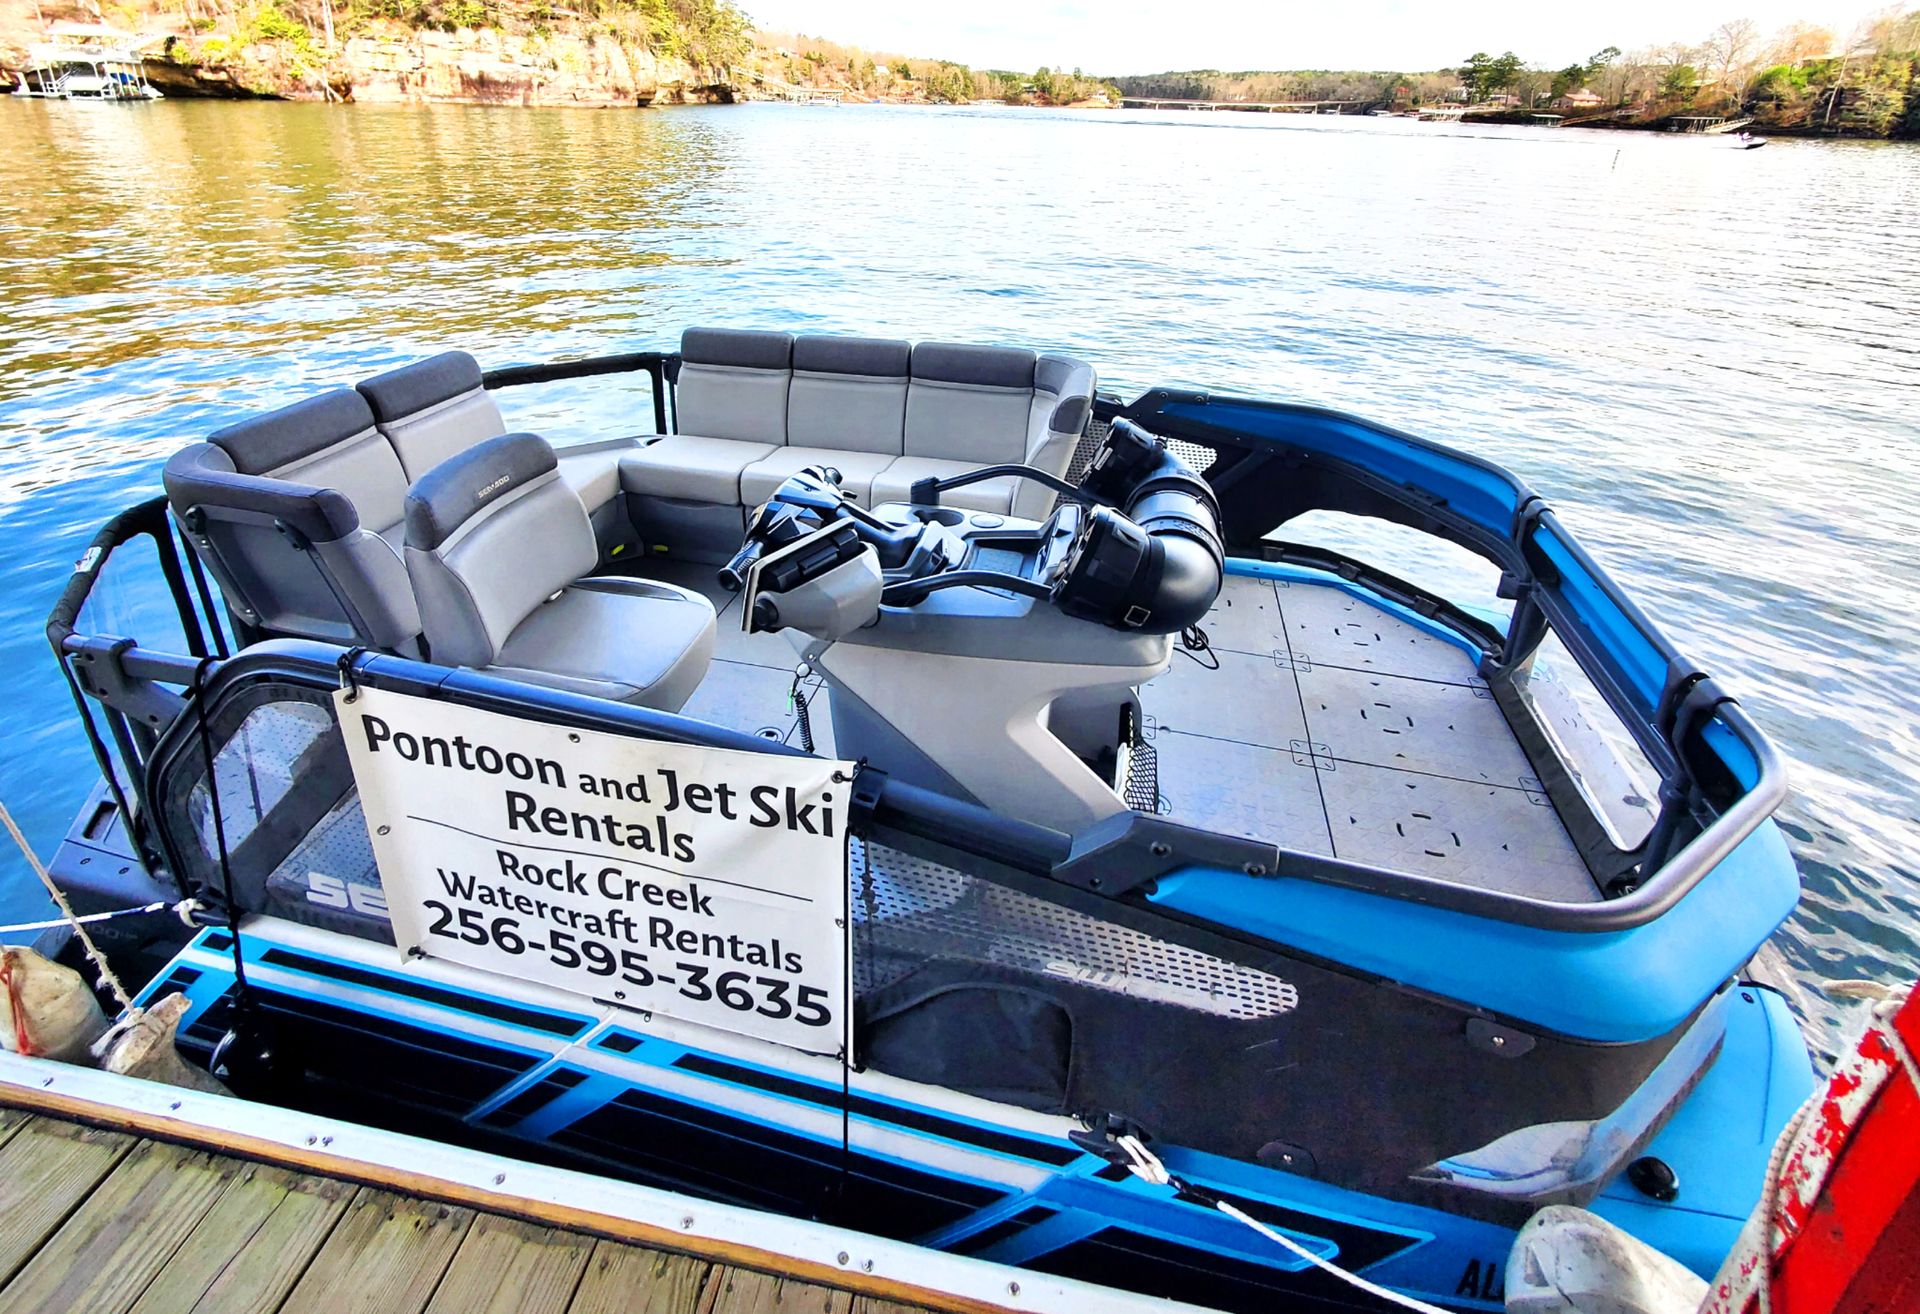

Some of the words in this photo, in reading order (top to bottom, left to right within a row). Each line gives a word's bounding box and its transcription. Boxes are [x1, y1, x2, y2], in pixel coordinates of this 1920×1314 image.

[361, 713, 567, 789] Pontoon
[578, 773, 651, 804] and
[657, 768, 737, 820] Jet
[749, 785, 834, 838] Ski
[505, 789, 696, 863] Rentals
[436, 867, 639, 944] Watercraft
[649, 916, 804, 974] Rentals
[496, 849, 589, 897] Rock
[597, 867, 716, 917] Creek
[422, 900, 832, 1027] 256-595-3635
